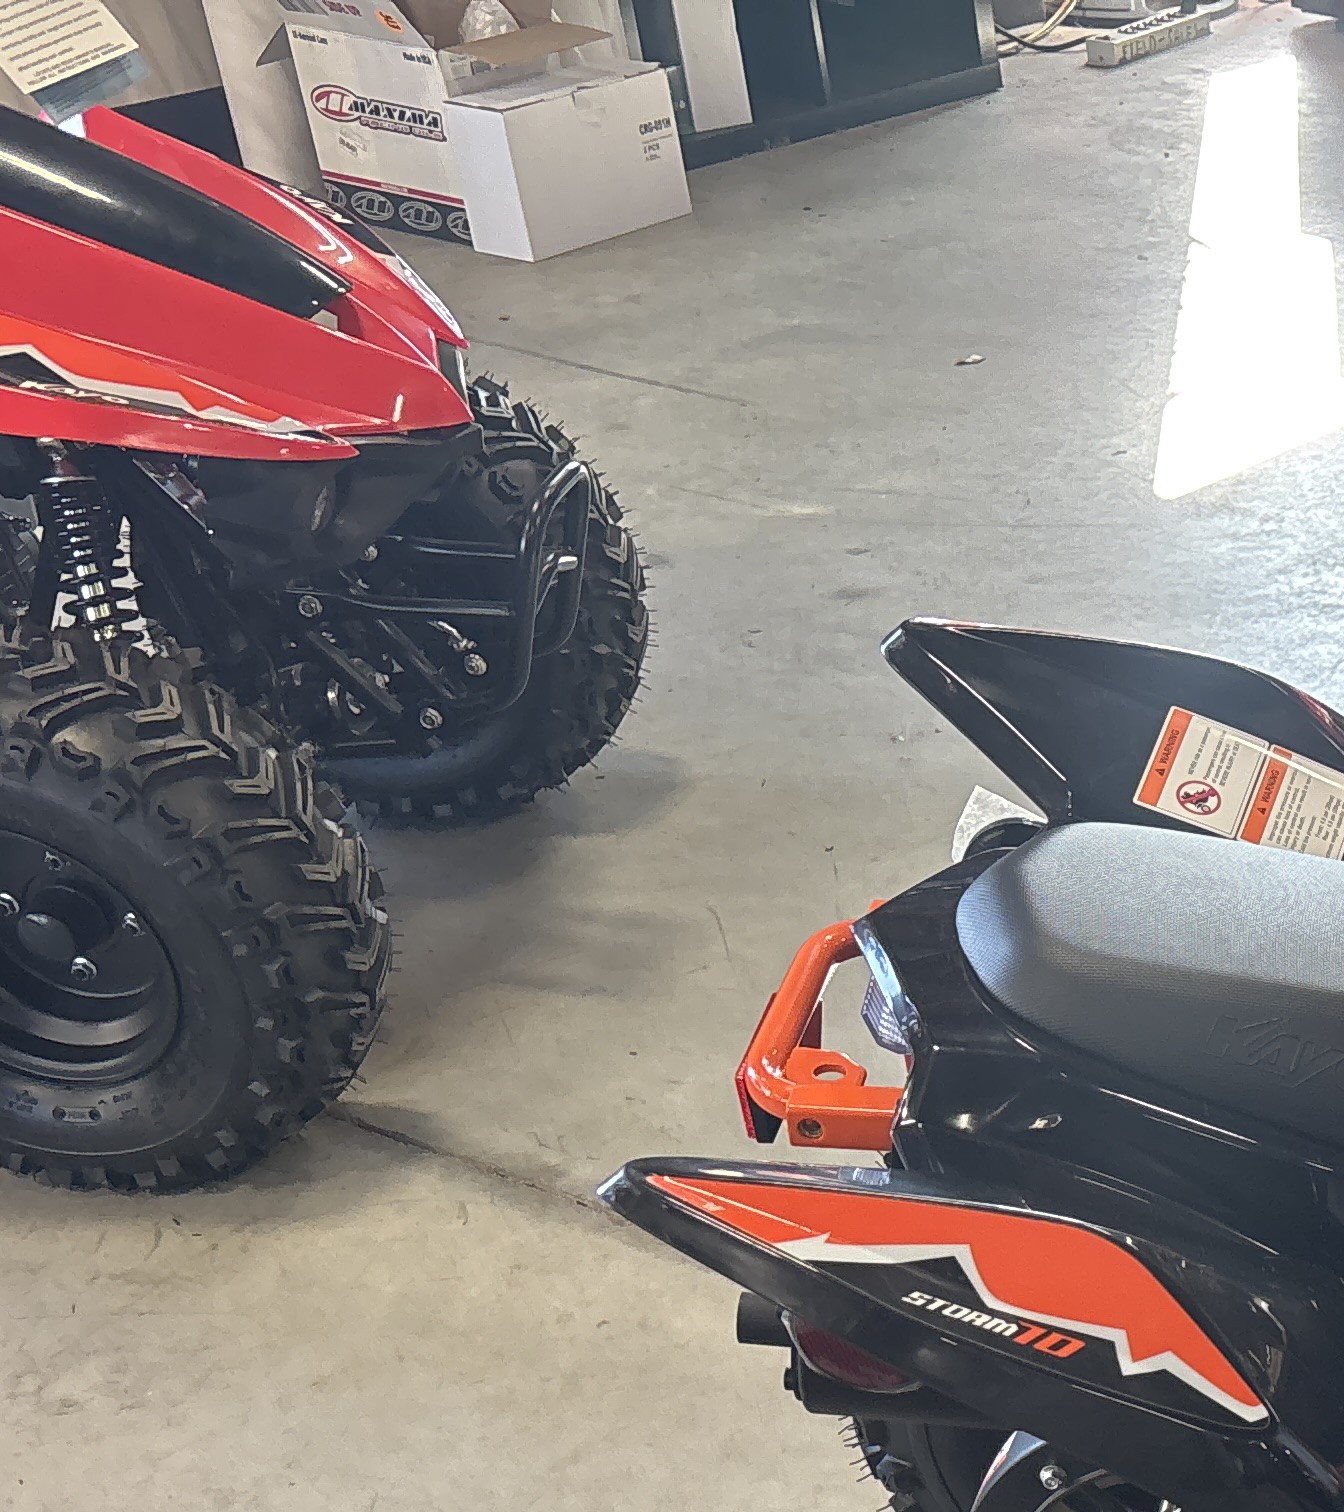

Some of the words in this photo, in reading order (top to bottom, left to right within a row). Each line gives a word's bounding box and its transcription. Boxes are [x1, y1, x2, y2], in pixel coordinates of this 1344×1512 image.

[348, 100, 441, 129] MAXIMA
[1159, 729, 1179, 763] WARNING
[1260, 769, 1279, 802] WARNING
[901, 1291, 1086, 1358] STORM70
